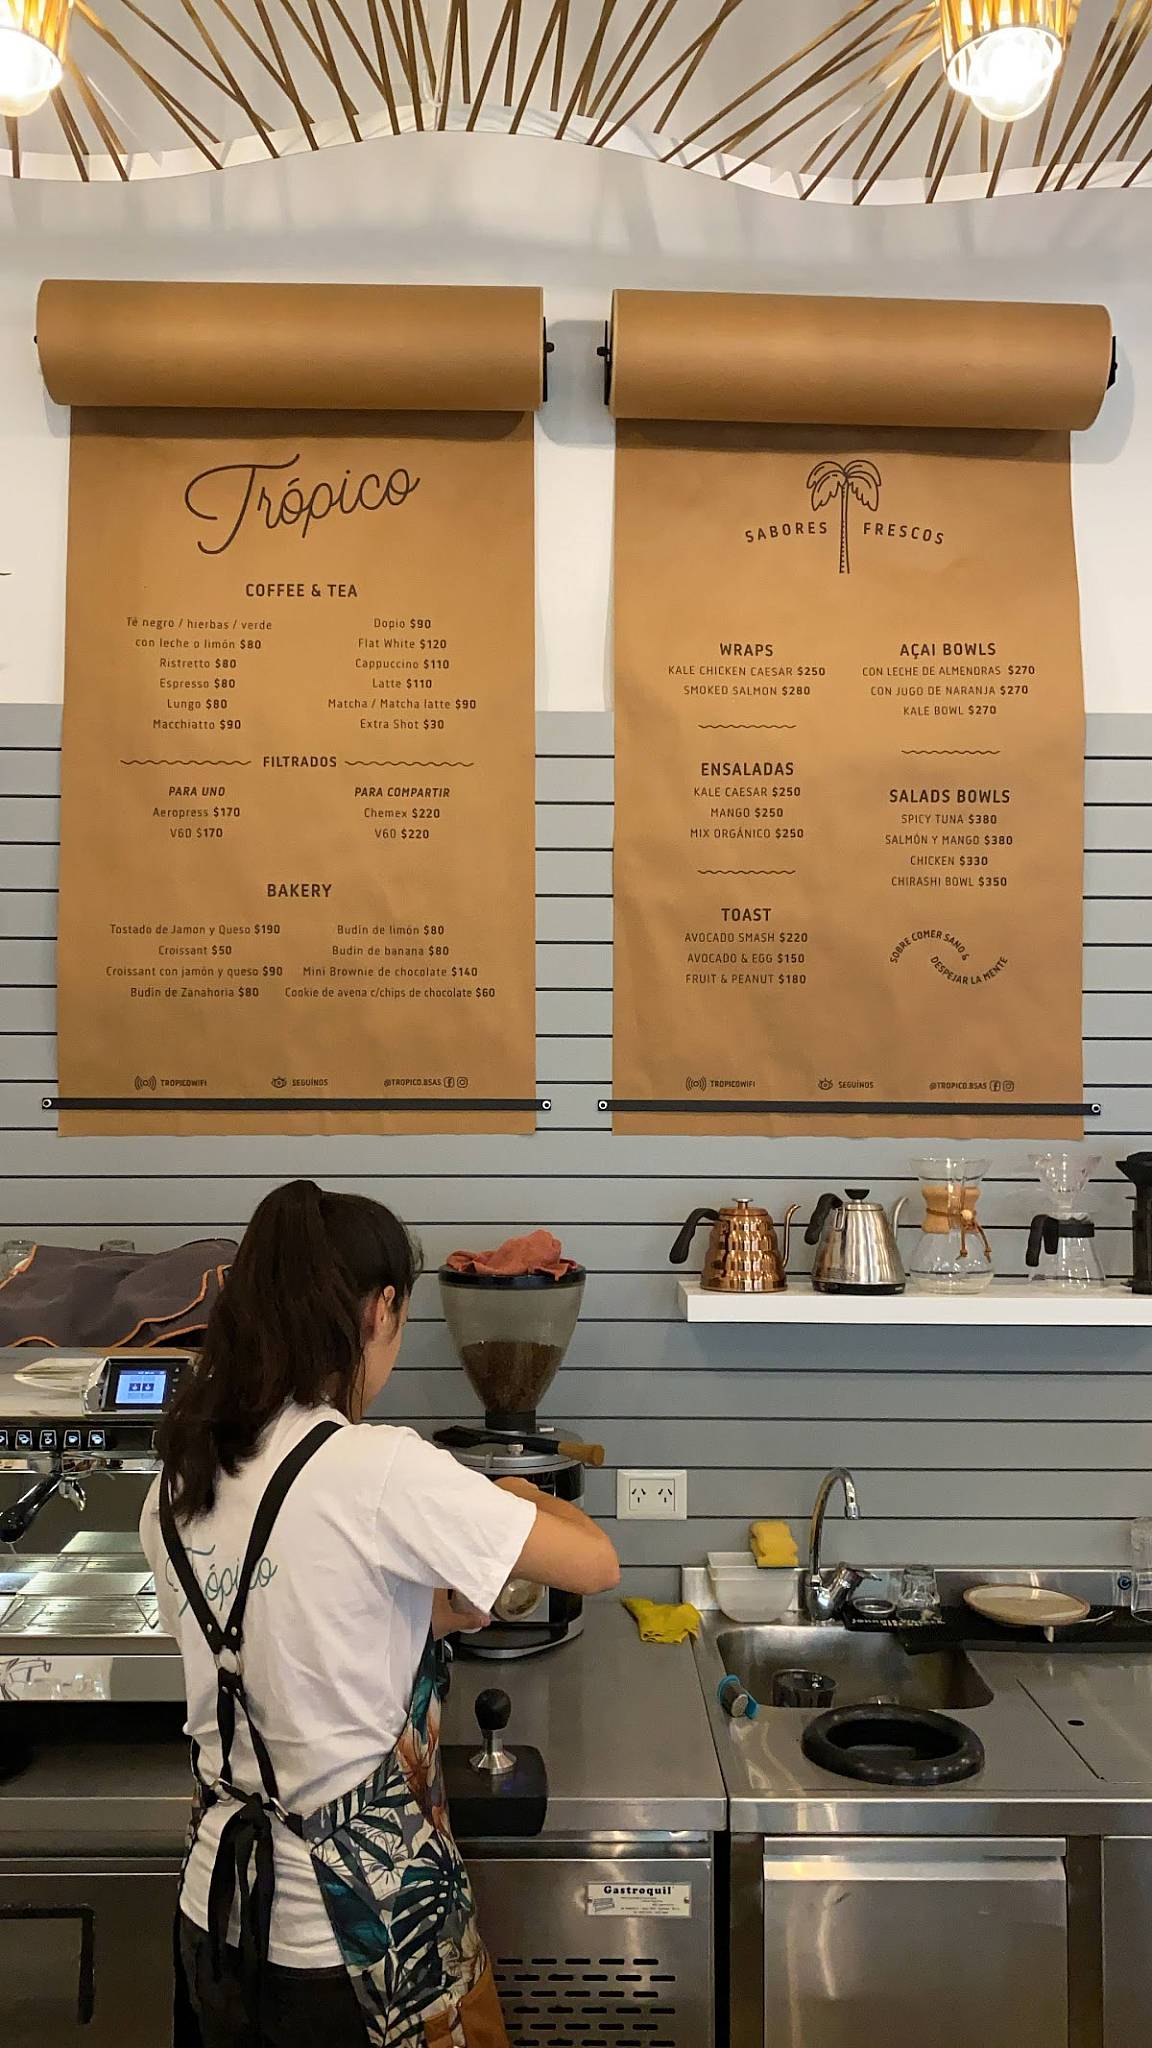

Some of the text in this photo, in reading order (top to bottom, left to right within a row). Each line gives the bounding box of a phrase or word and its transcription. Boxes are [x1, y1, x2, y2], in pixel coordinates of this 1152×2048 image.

[185, 454, 420, 554] Trópico
[746, 522, 826, 542] SABORES
[864, 522, 943, 544] FRESCOS
[245, 583, 305, 597] COFFEE
[326, 583, 358, 598] TEA
[142, 619, 175, 631] negro
[187, 618, 229, 630] hierbas
[240, 619, 273, 631] verde
[373, 617, 432, 631] Dopio $90
[135, 639, 155, 647] con
[159, 637, 189, 649] leche
[239, 639, 262, 650] $80
[358, 637, 447, 651] Flat White $120
[719, 642, 774, 657] WRAPS
[899, 642, 997, 660] AÇAI BOWLS
[159, 657, 237, 669] Ristretto $80
[355, 657, 450, 671] Cappuccino $110
[668, 665, 826, 677] KALE CHICKEN CAESAR $250
[862, 664, 1035, 677] CON LECHE ALMENDRAS $270
[159, 677, 236, 690] Espresso $80
[372, 677, 433, 689] Latte $110
[683, 685, 811, 697] SMOKED SALMON $280
[870, 684, 1029, 697] CON JUGO DE NARANJA $270
[167, 698, 228, 712] Lungo $80
[327, 698, 477, 711] Matcha Matcha latte $90
[903, 704, 997, 717] KALE BOWL $270
[153, 719, 242, 731] Macchiatto $90
[359, 718, 445, 731] Extra Shot $30
[263, 755, 337, 768] FILTRADOS
[701, 761, 794, 777] ENSALADAS
[168, 786, 226, 797] PARA UNO
[354, 786, 451, 798] PARA COMPARTIR
[693, 786, 801, 798] KALE CAESAR $250
[889, 788, 1010, 804] SALADS BOWLS
[152, 805, 241, 820] Aeropress $170
[363, 807, 441, 819] Chemex $220
[710, 807, 784, 819] MANGO $250
[901, 813, 997, 825] SPICY TUNA $380
[169, 827, 223, 839] V60 $170
[374, 827, 430, 840] V60 $220
[690, 826, 804, 840] MIX ORGÁNICO $250
[885, 833, 1013, 846] SALMÓN Y MANGO $380
[910, 855, 989, 867] CHICKEN $330
[891, 875, 1007, 887] CHIRASHI BOWL $350
[267, 883, 332, 898] BAKERY
[720, 907, 772, 922] TOAST
[109, 923, 281, 936] Tostado Queso $190
[423, 924, 445, 937] $80
[684, 931, 809, 943] AVOCADO SMASH $220
[158, 944, 233, 956] Croissant $50
[384, 945, 450, 957] banana $80
[890, 930, 966, 964] SOBRE COMER SANO
[687, 952, 737, 964] AVOCADO
[751, 953, 773, 964] EGG
[777, 952, 805, 964] $150
[105, 965, 156, 977] Croissant
[159, 967, 179, 977] con
[226, 967, 259, 979] queso
[262, 965, 283, 977] $90
[303, 965, 478, 978] Mini Brownie de chocolate $140
[930, 956, 1008, 985] DESPEJAR LA MENTE
[685, 973, 717, 985] FRUIT
[731, 973, 774, 985] PEANUT
[777, 973, 807, 985] $180
[180, 985, 259, 998] Zanahoria $80
[285, 986, 496, 1000] Cookie de avena c/chips de chocolate $60
[603, 1885, 672, 1896] Gastroquil
